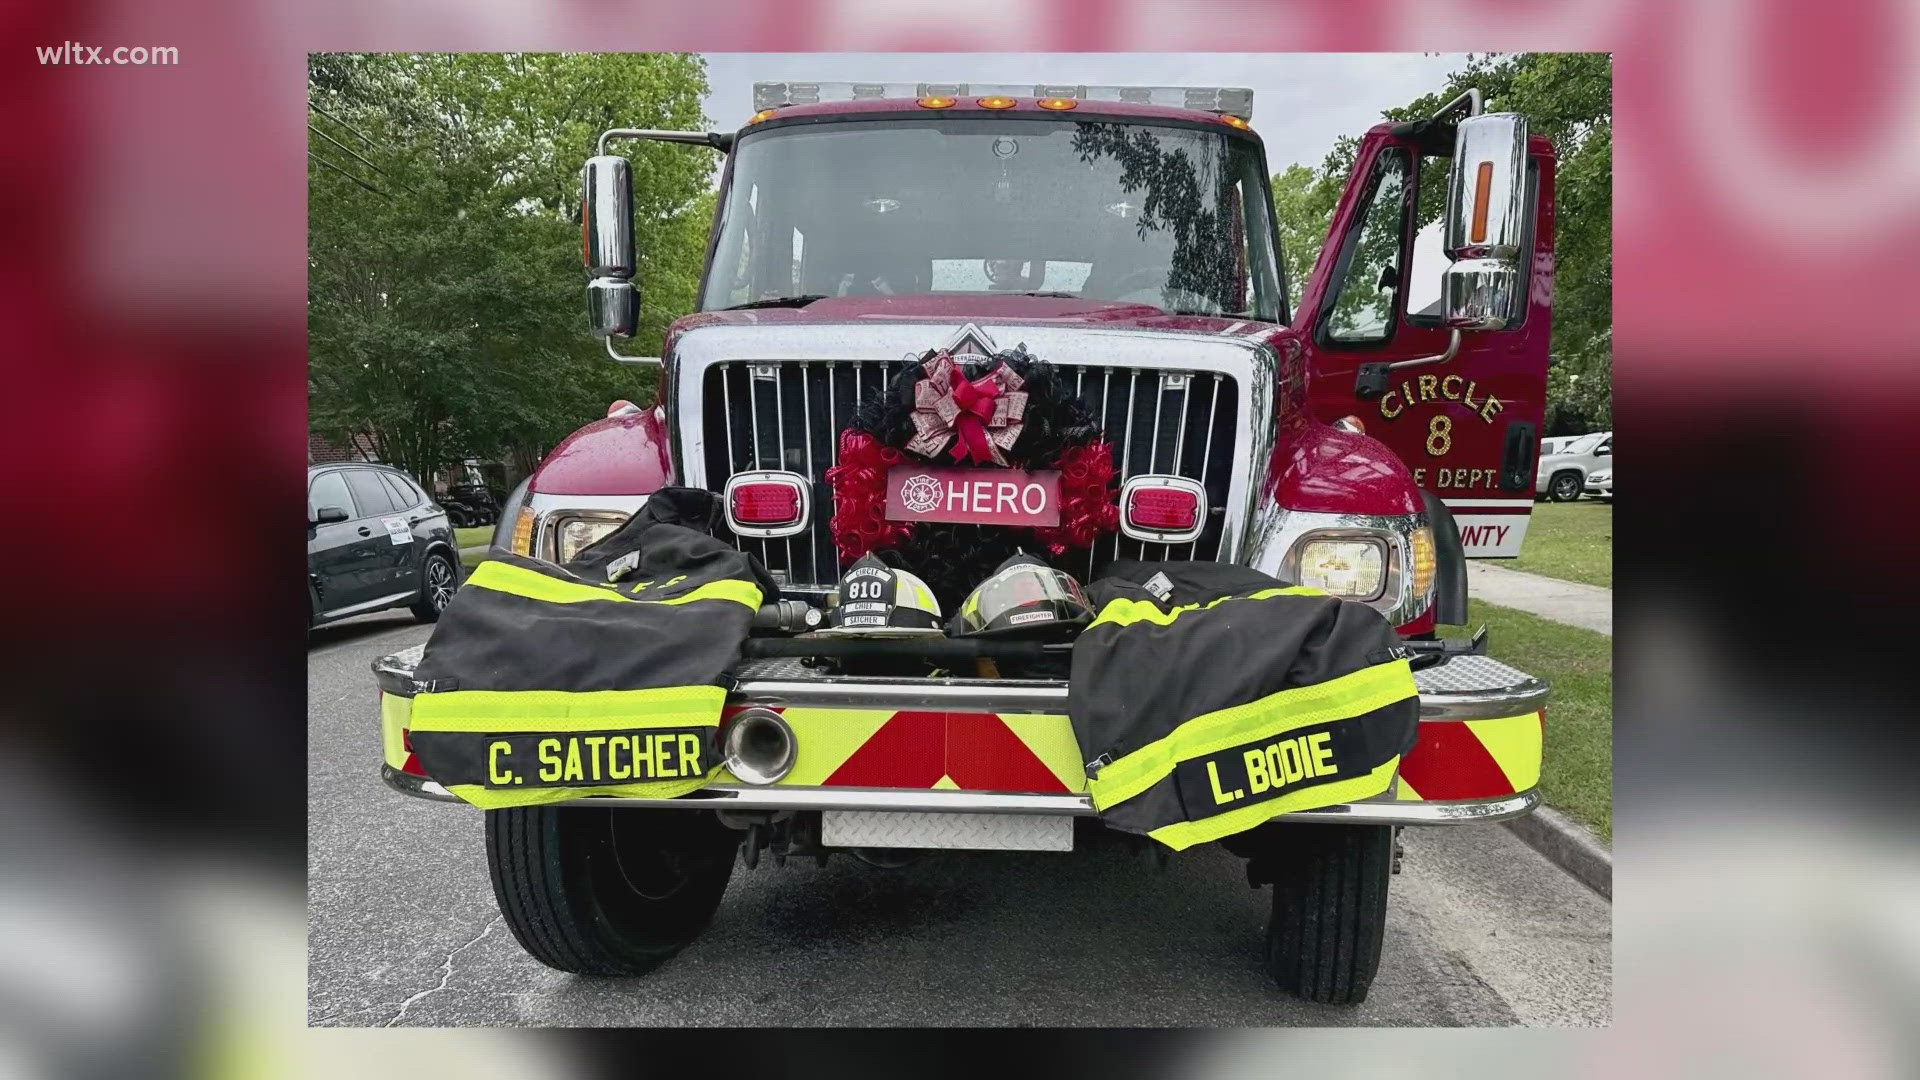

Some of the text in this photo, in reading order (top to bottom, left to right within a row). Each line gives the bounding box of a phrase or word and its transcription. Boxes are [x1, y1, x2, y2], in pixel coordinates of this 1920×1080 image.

[1380, 374, 1503, 424] CIRCLE
[1426, 415, 1451, 456] 8
[1437, 468, 1498, 488] DEPT.
[946, 480, 1047, 515] HERO
[855, 568, 879, 576] CIRCLE
[849, 581, 882, 599] 810
[854, 602, 874, 610] CHIEF
[849, 616, 878, 625] SATCHER
[1011, 611, 1053, 623] FIREFIGHTER
[489, 733, 702, 785] C. SATCHER
[1206, 731, 1338, 805] L. BODIE
